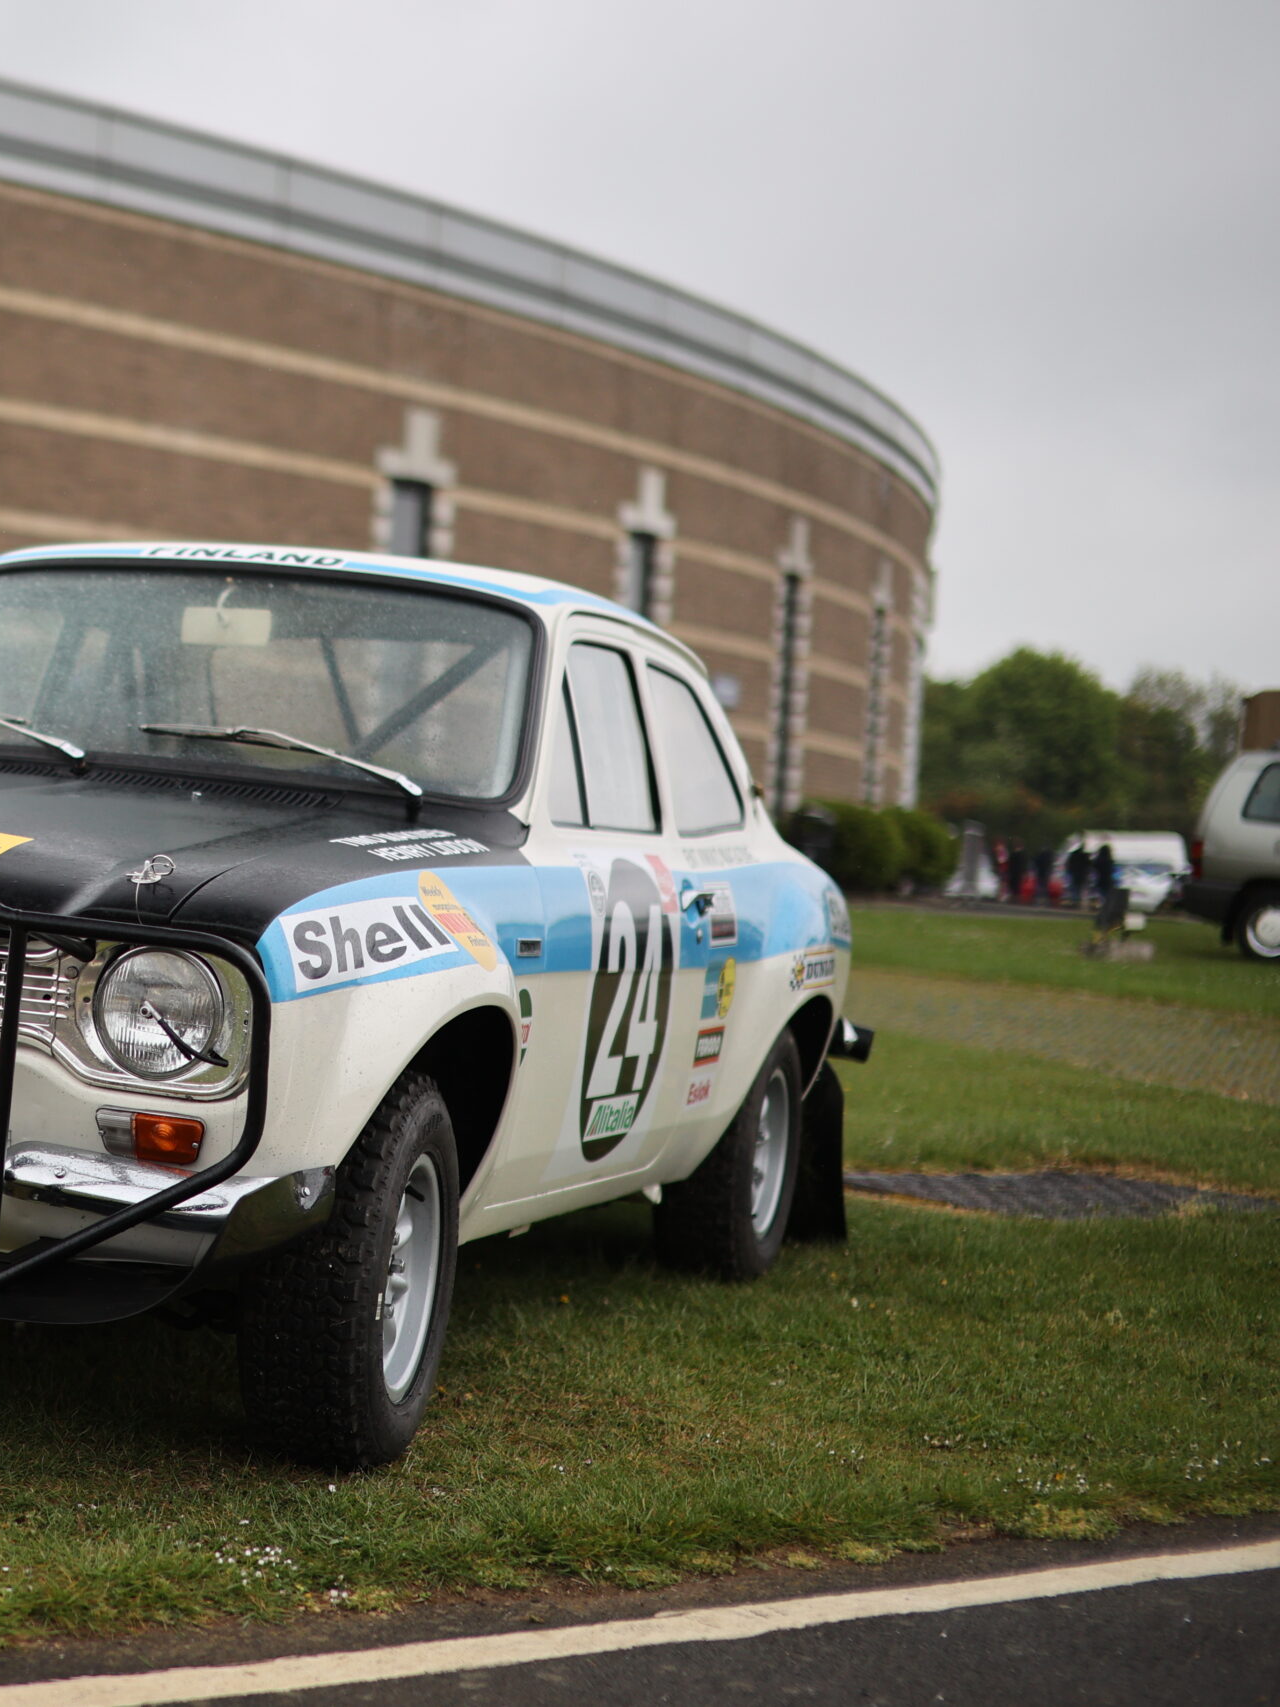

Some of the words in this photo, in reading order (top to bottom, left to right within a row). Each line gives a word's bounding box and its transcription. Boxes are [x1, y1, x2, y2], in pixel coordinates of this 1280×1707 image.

[149, 546, 345, 567] FINLAND
[368, 843, 436, 862] HENRY
[293, 904, 452, 981] Shell
[585, 900, 662, 1100] 24
[586, 1101, 635, 1137] Alitalia
